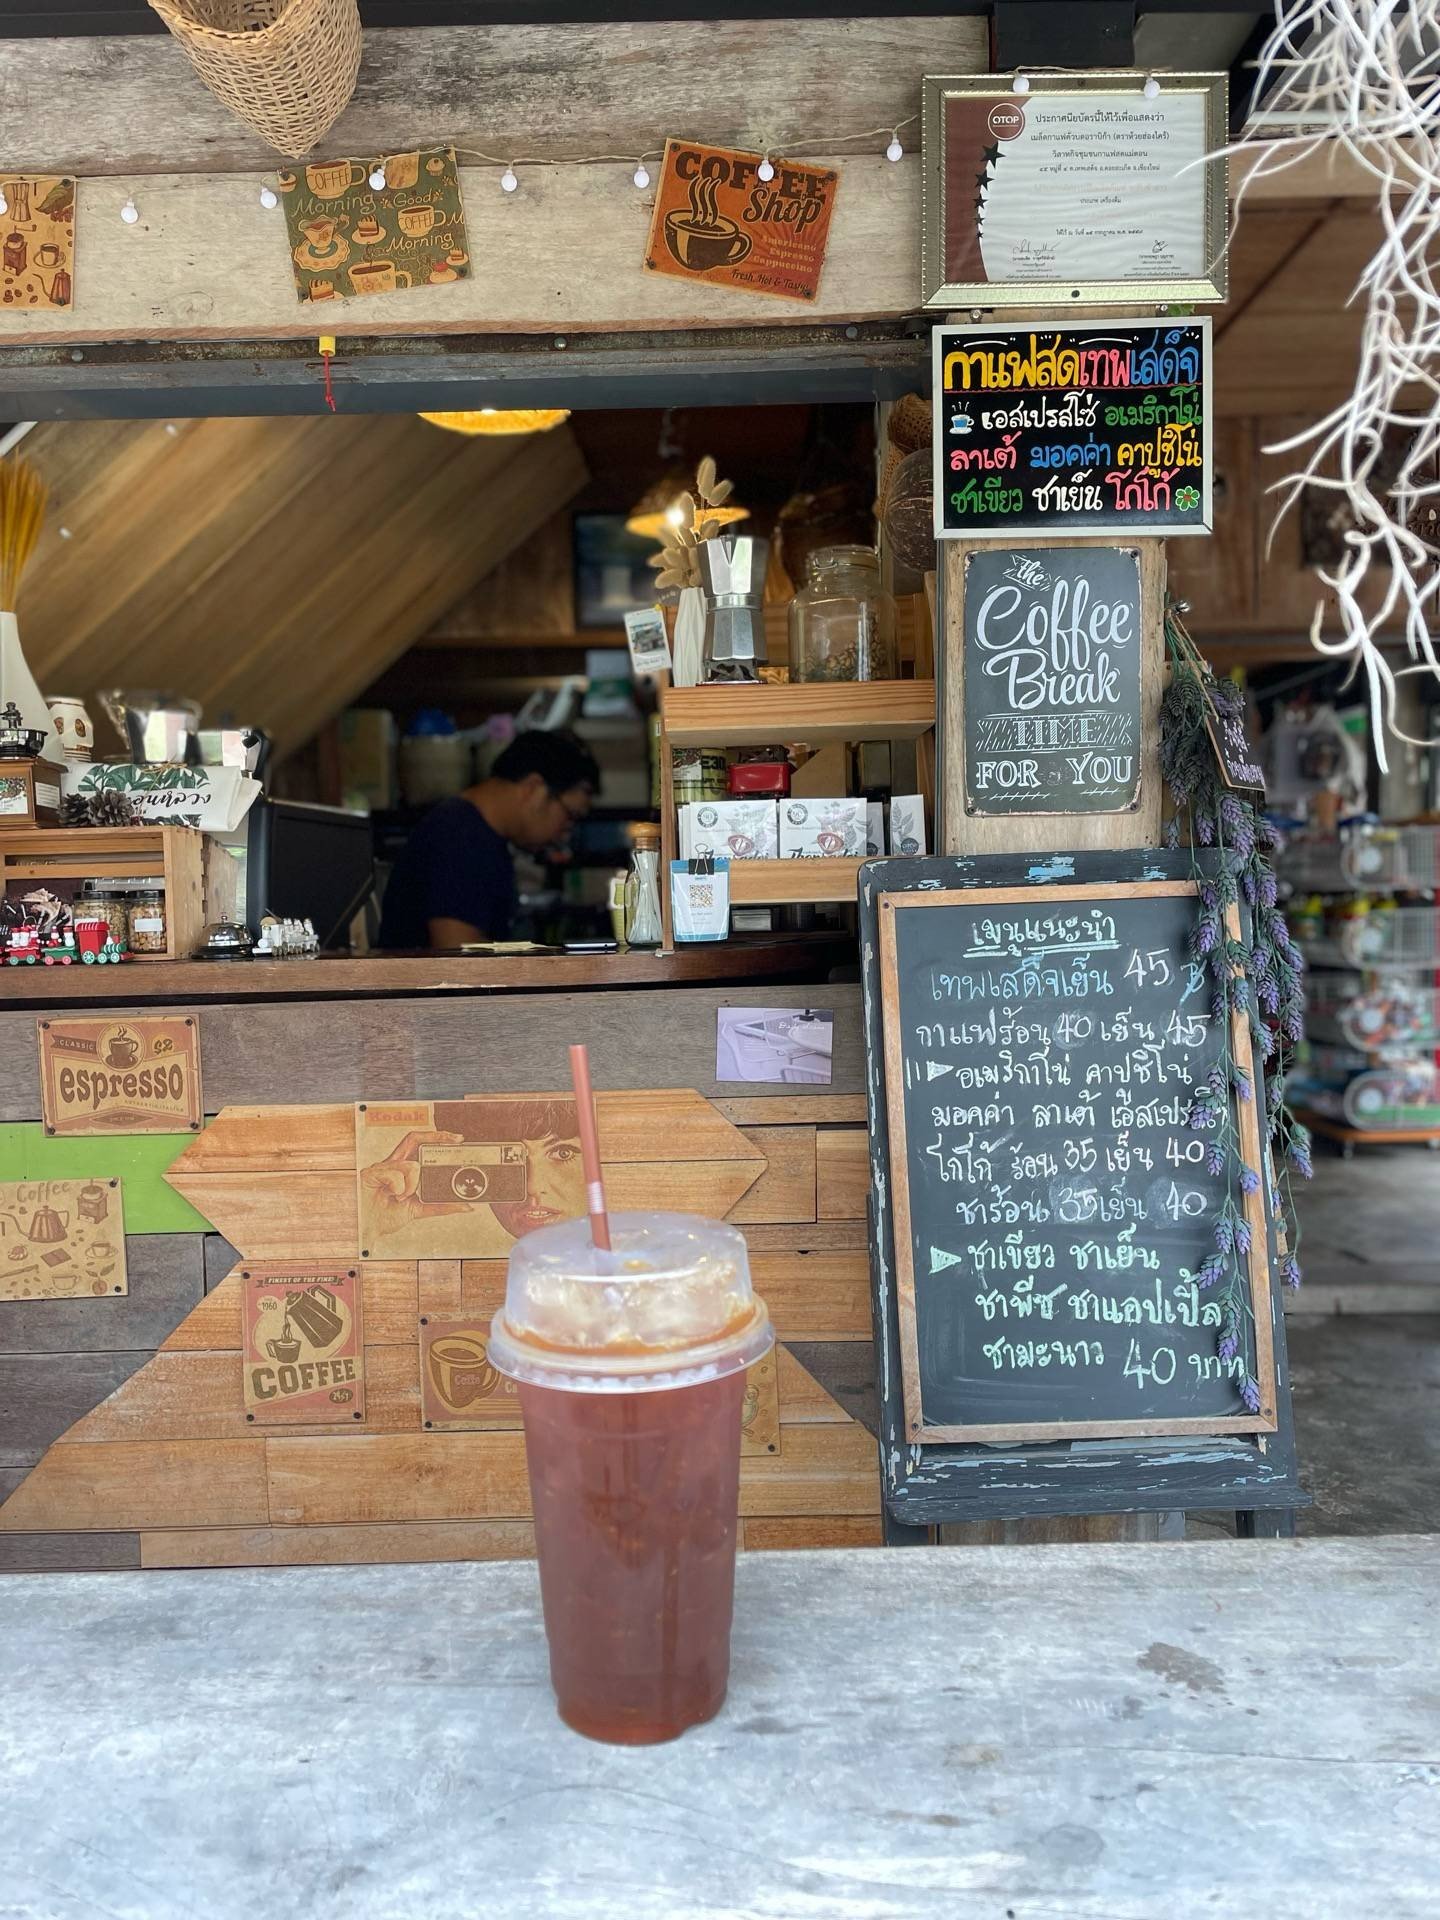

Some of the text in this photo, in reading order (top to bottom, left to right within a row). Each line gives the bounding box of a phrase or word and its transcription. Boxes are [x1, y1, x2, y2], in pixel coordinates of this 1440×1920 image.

[992, 115, 1020, 125] OTOP
[291, 193, 377, 217] Morning
[393, 188, 433, 208] Good
[743, 187, 822, 234] Shop
[386, 232, 455, 252] Morning
[981, 385, 1203, 430] เอสเปรสโซ่ อเมริกาโน่
[950, 423, 1203, 478] ลาเต้ มอคค่า คาปูชิโน่
[950, 466, 1181, 513] ชาเขียว ชาเย็น โกโก้
[976, 578, 1133, 672] Coffee
[984, 648, 1121, 710] Break
[1012, 717, 1098, 747] TIME
[975, 751, 1133, 789] FOR YOU
[972, 909, 1117, 957] เมนูแนะนำ
[1123, 948, 1170, 987] 45
[58, 1038, 94, 1050] CLASSIC
[916, 1006, 1212, 1047] กาแฟร้อน 40 เย็น 45
[60, 1063, 184, 1110] espresso
[955, 1047, 1071, 1089] อเมริกาโน่
[931, 1090, 1014, 1128] มอคค่า
[1032, 1089, 1102, 1128] ลาเต้
[926, 1131, 1205, 1183] โกโก้ ร้อน 35 เย็น 40
[17, 1181, 71, 1203] Coffee
[956, 1177, 1208, 1225] ชาร้อน 35 เย็น 40
[968, 1223, 1160, 1270] ชาเขียว ชาเย็น
[261, 1301, 278, 1311] 1960
[251, 1358, 356, 1400] COFFEE
[982, 1336, 1105, 1370] ชามะนาว
[1123, 1338, 1177, 1390] 40
